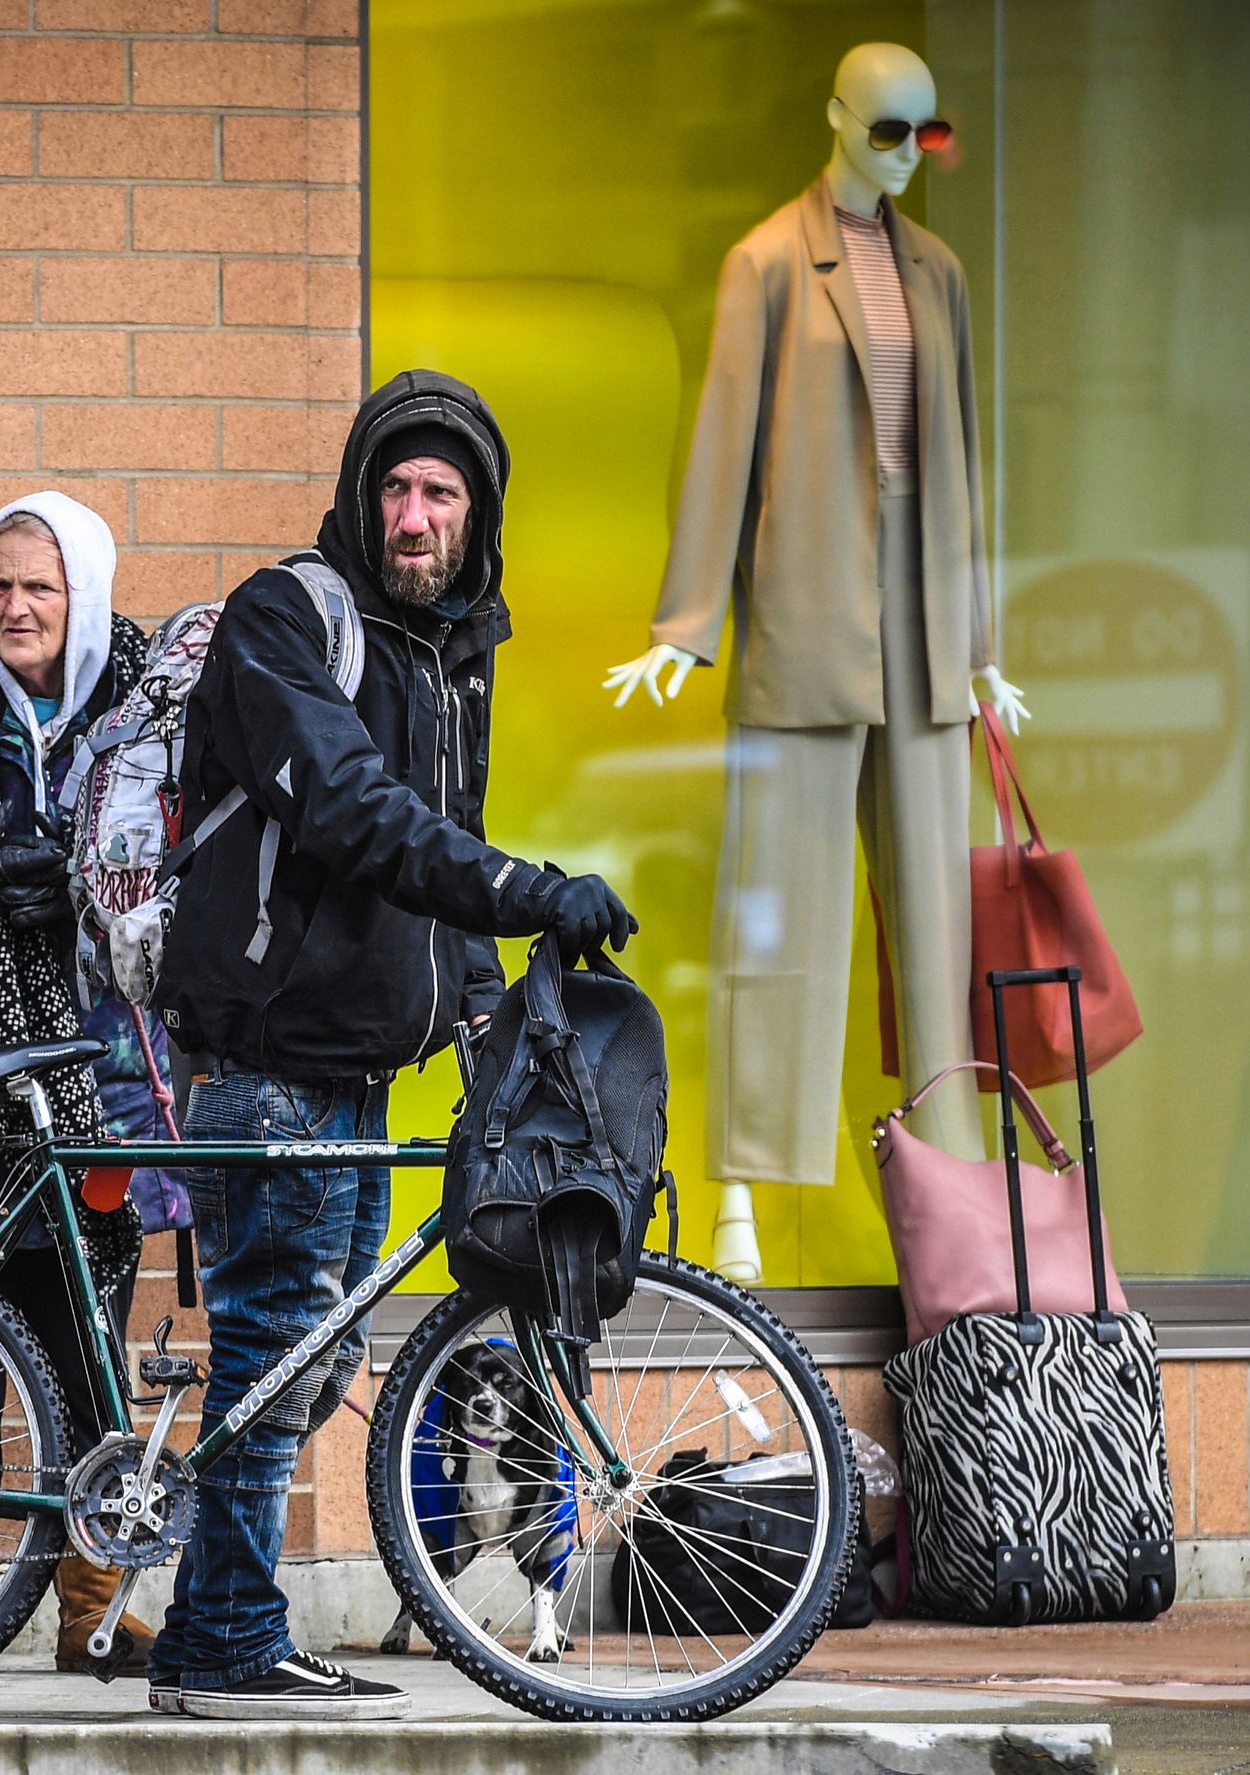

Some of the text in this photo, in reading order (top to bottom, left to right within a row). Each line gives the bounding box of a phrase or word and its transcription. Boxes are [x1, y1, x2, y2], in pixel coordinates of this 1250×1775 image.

[327, 621, 340, 677] AKINE
[267, 1143, 398, 1156] SYCAMORE
[226, 1230, 424, 1432] MONGOOSE
